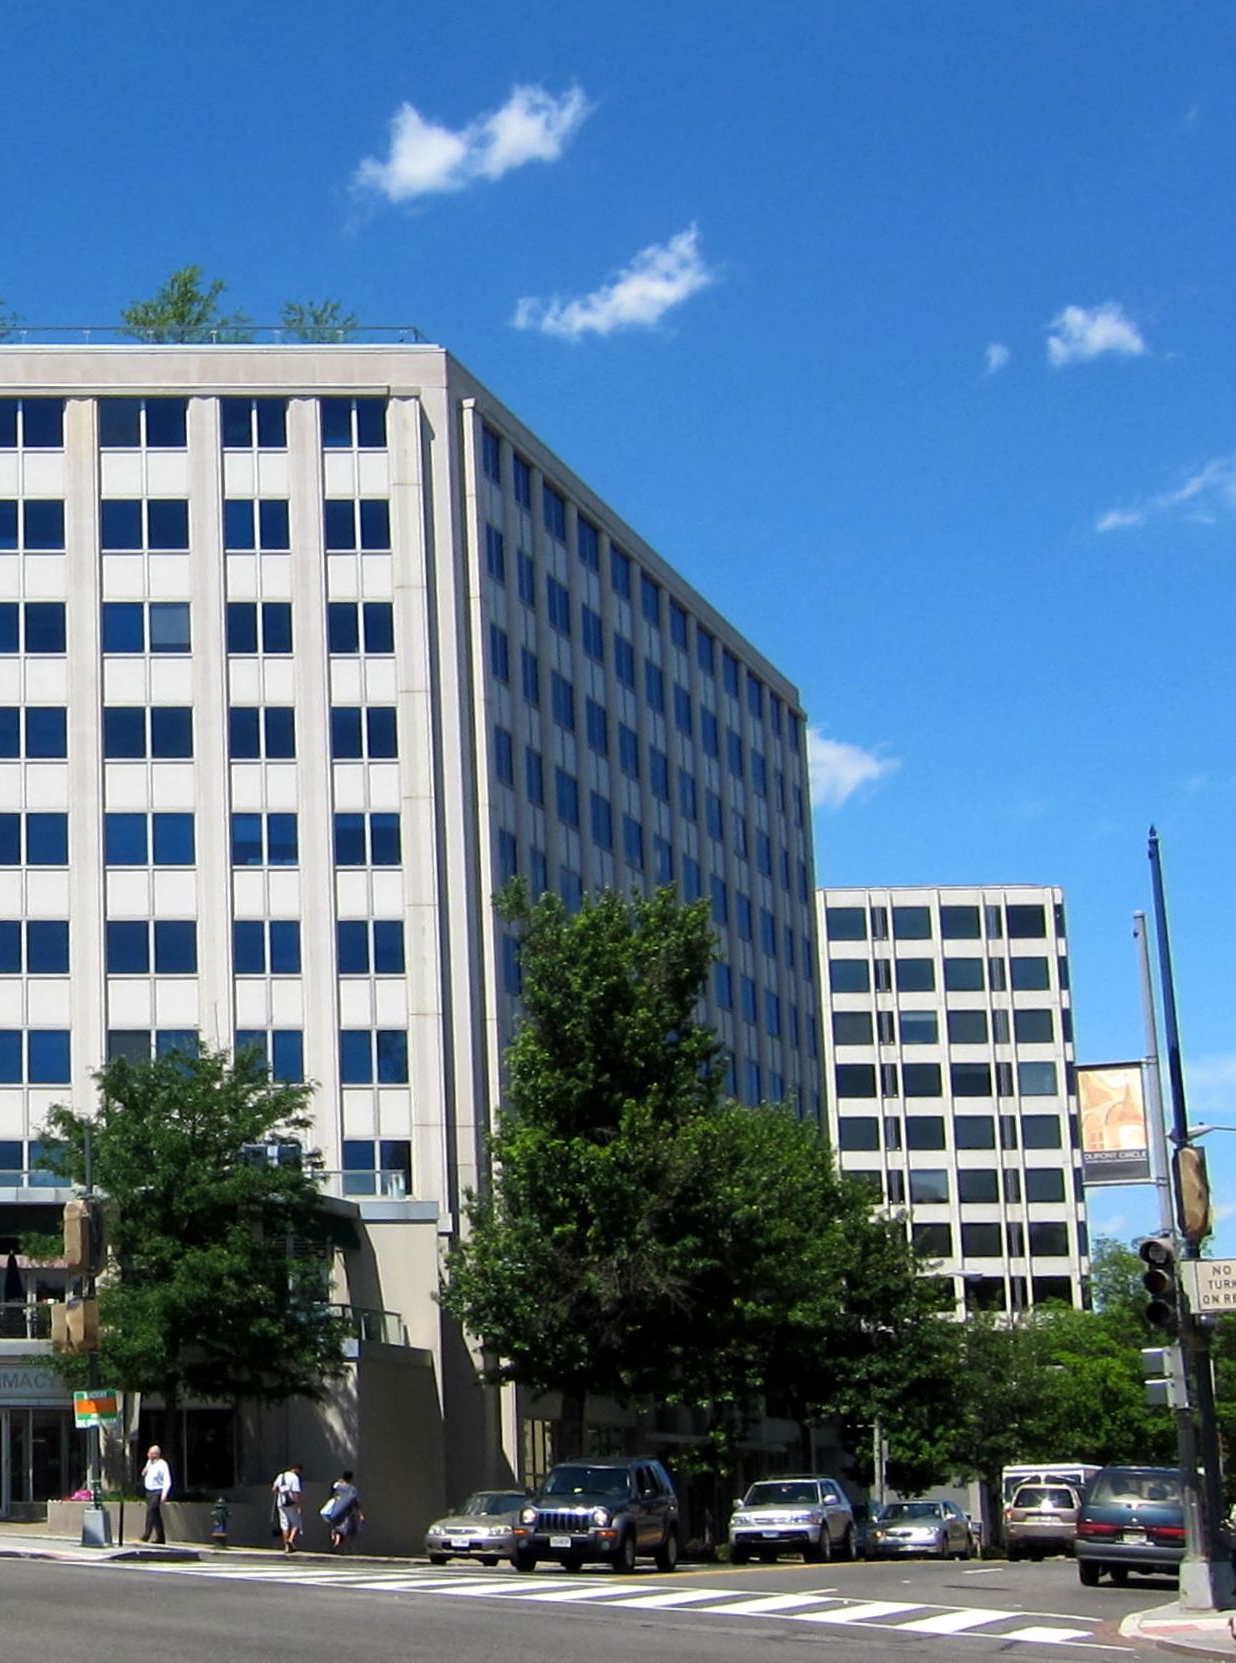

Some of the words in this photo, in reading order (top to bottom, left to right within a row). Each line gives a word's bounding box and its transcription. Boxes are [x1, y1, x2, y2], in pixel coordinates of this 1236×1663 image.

[1119, 1151, 1146, 1159] CIRCLE
[1212, 1265, 1232, 1276] NO
[1202, 1295, 1219, 1304] ON
[1224, 1294, 1236, 1303] RE
